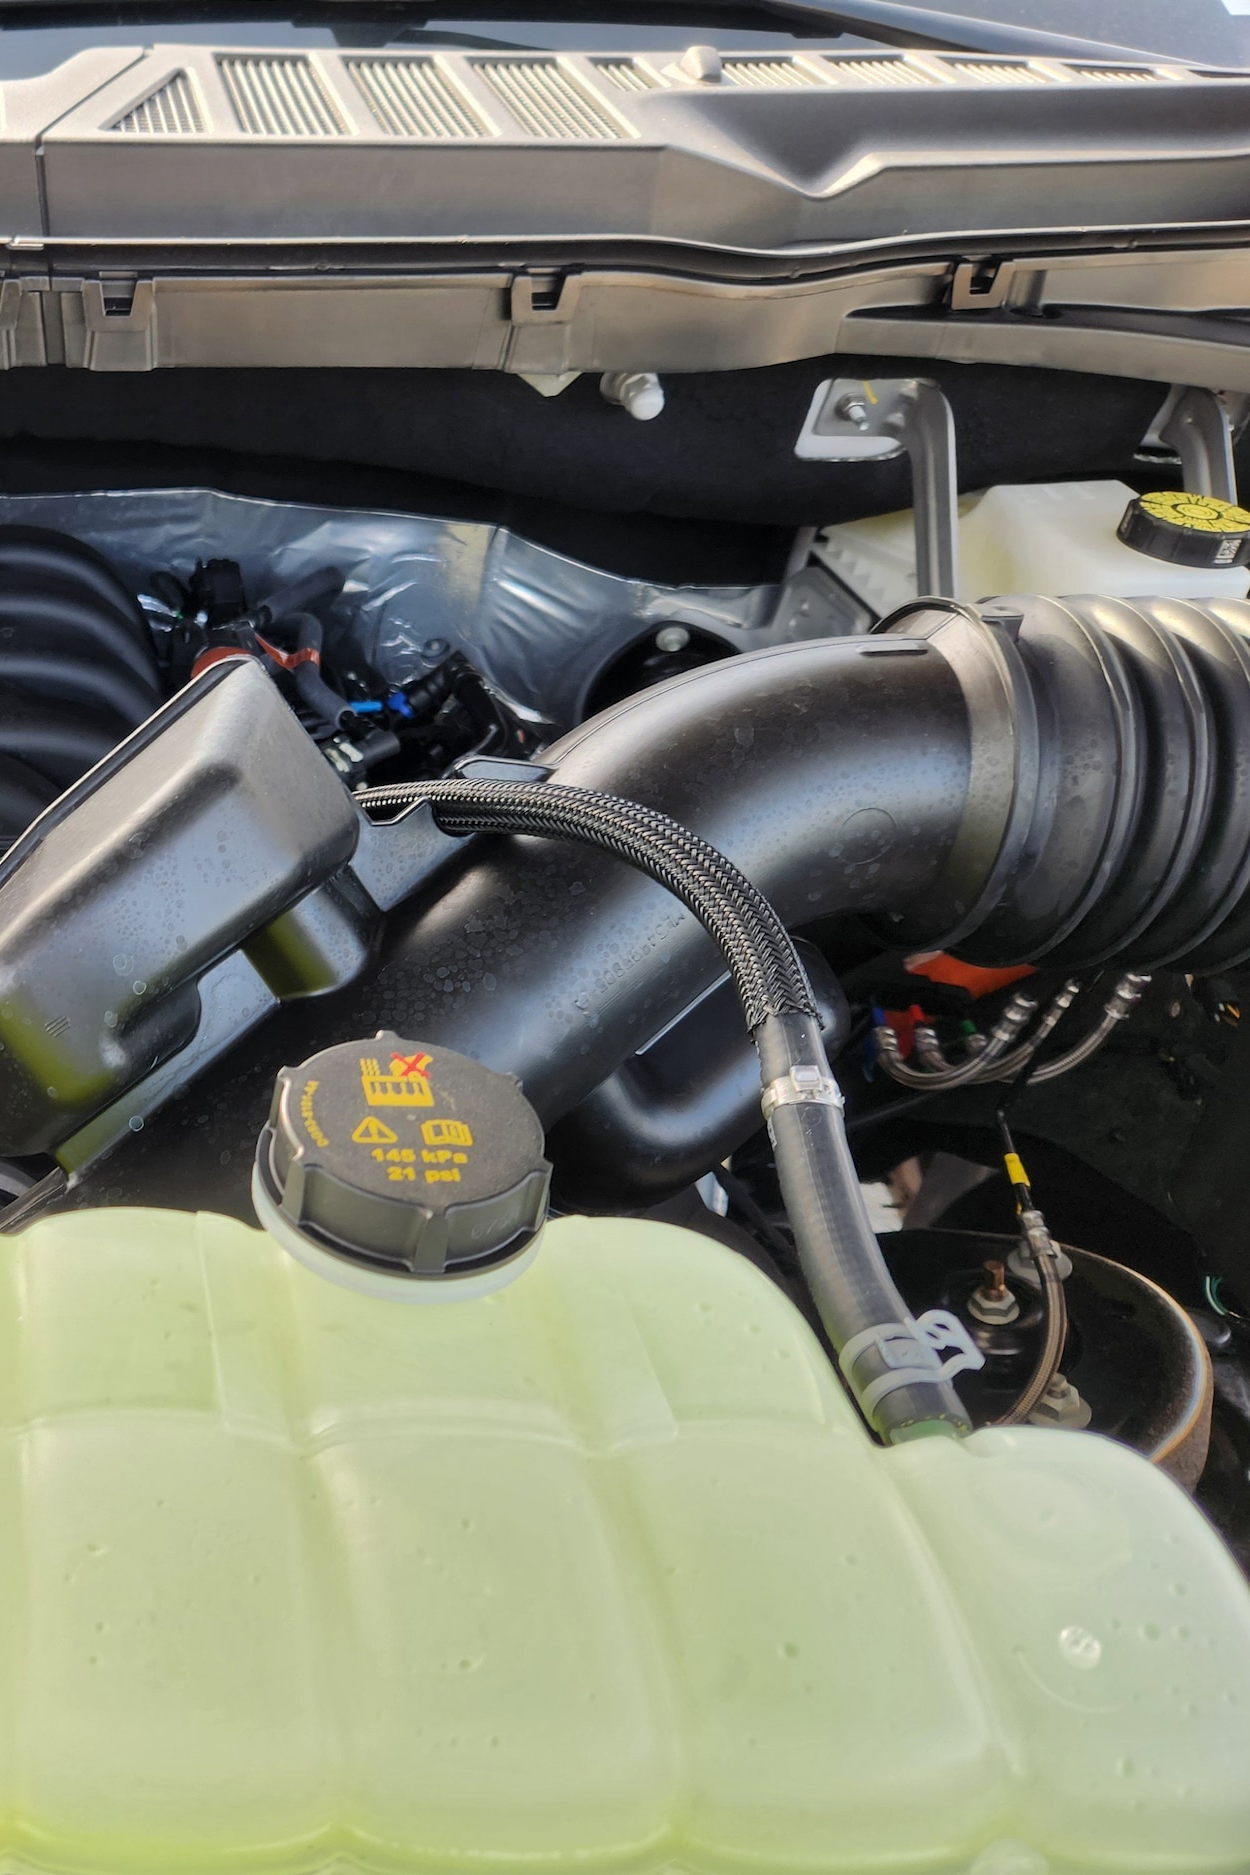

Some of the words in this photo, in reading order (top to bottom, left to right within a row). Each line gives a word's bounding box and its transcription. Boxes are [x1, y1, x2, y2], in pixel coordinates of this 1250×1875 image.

[371, 1147, 417, 1163] 145
[421, 1149, 469, 1164] kPa
[386, 1166, 416, 1181] 21
[425, 1167, 461, 1184] psi
